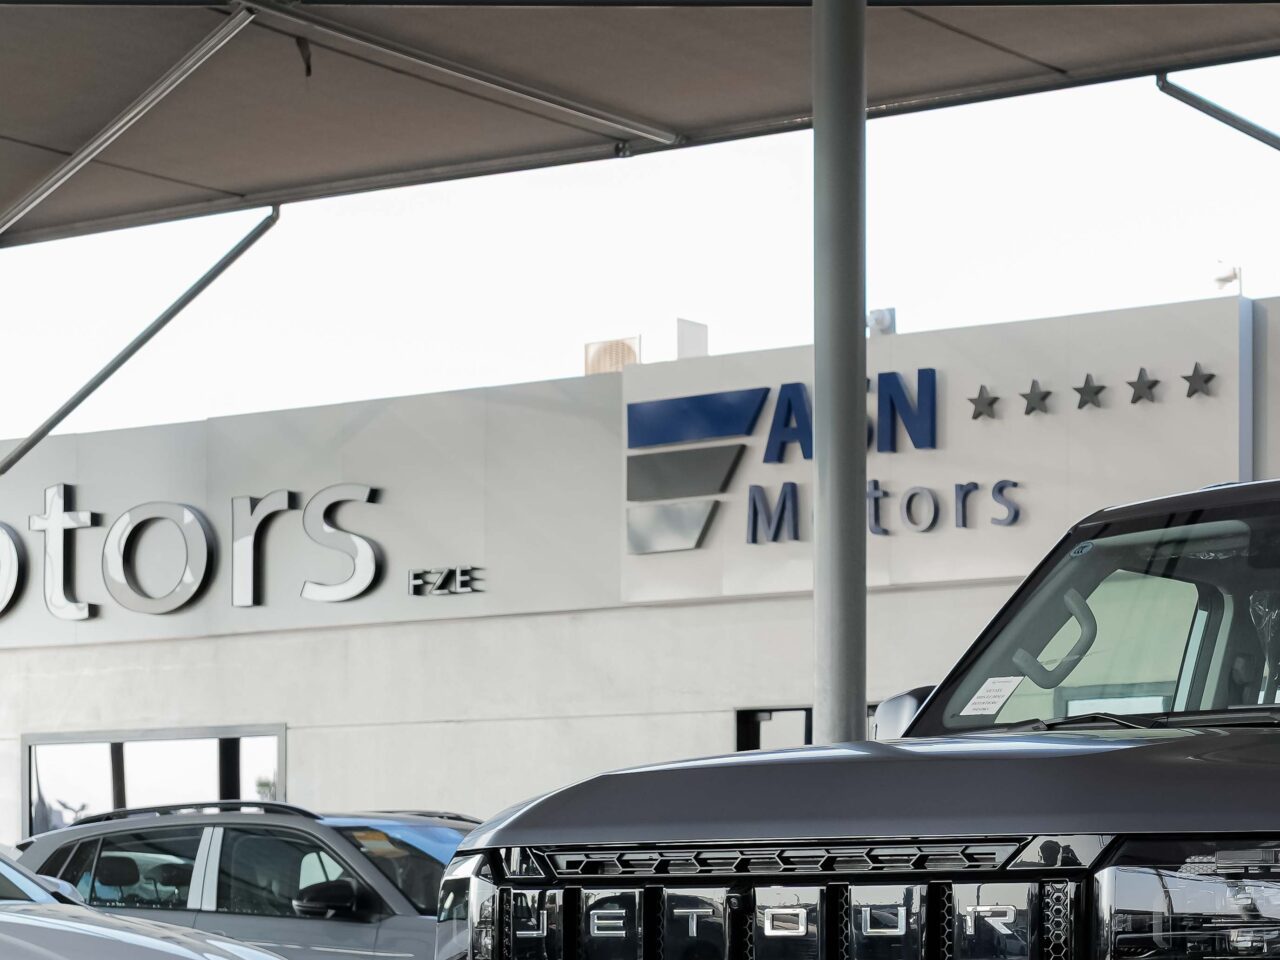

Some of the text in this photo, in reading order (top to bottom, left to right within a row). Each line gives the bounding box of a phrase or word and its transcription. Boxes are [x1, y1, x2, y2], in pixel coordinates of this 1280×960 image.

[763, 368, 937, 464] AN
[0, 482, 476, 620] tors FZE
[746, 478, 1022, 545] Mtors
[516, 904, 1017, 938] JETOUR
